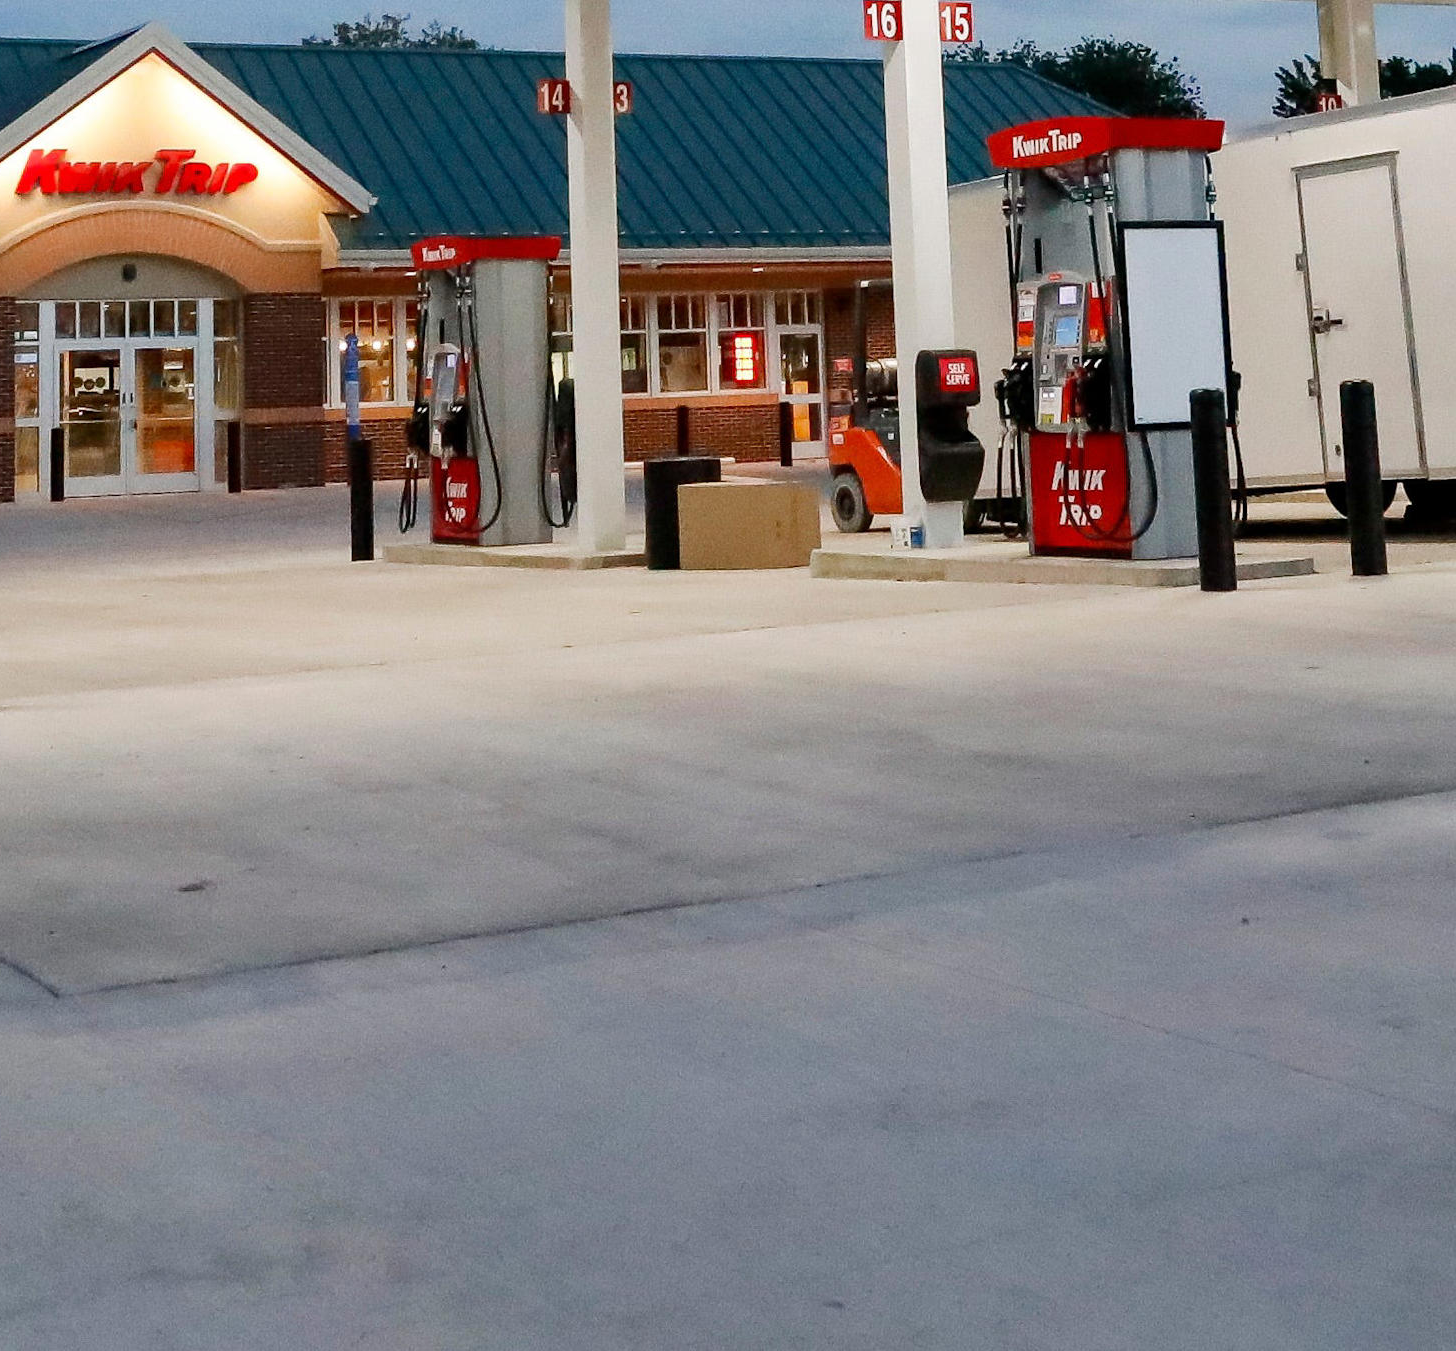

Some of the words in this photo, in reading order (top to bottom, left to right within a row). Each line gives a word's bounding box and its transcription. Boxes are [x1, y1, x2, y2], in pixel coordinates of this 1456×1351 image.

[866, 2, 897, 38] 16
[940, 6, 970, 41] 15
[541, 83, 564, 112] 14
[615, 83, 629, 113] 3
[1012, 135, 1050, 159] KWIK
[1048, 129, 1083, 153] TRIP
[15, 148, 154, 195] KWIK
[154, 148, 259, 195] TRIP
[946, 373, 970, 386] SERVE
[948, 362, 966, 374] SELF
